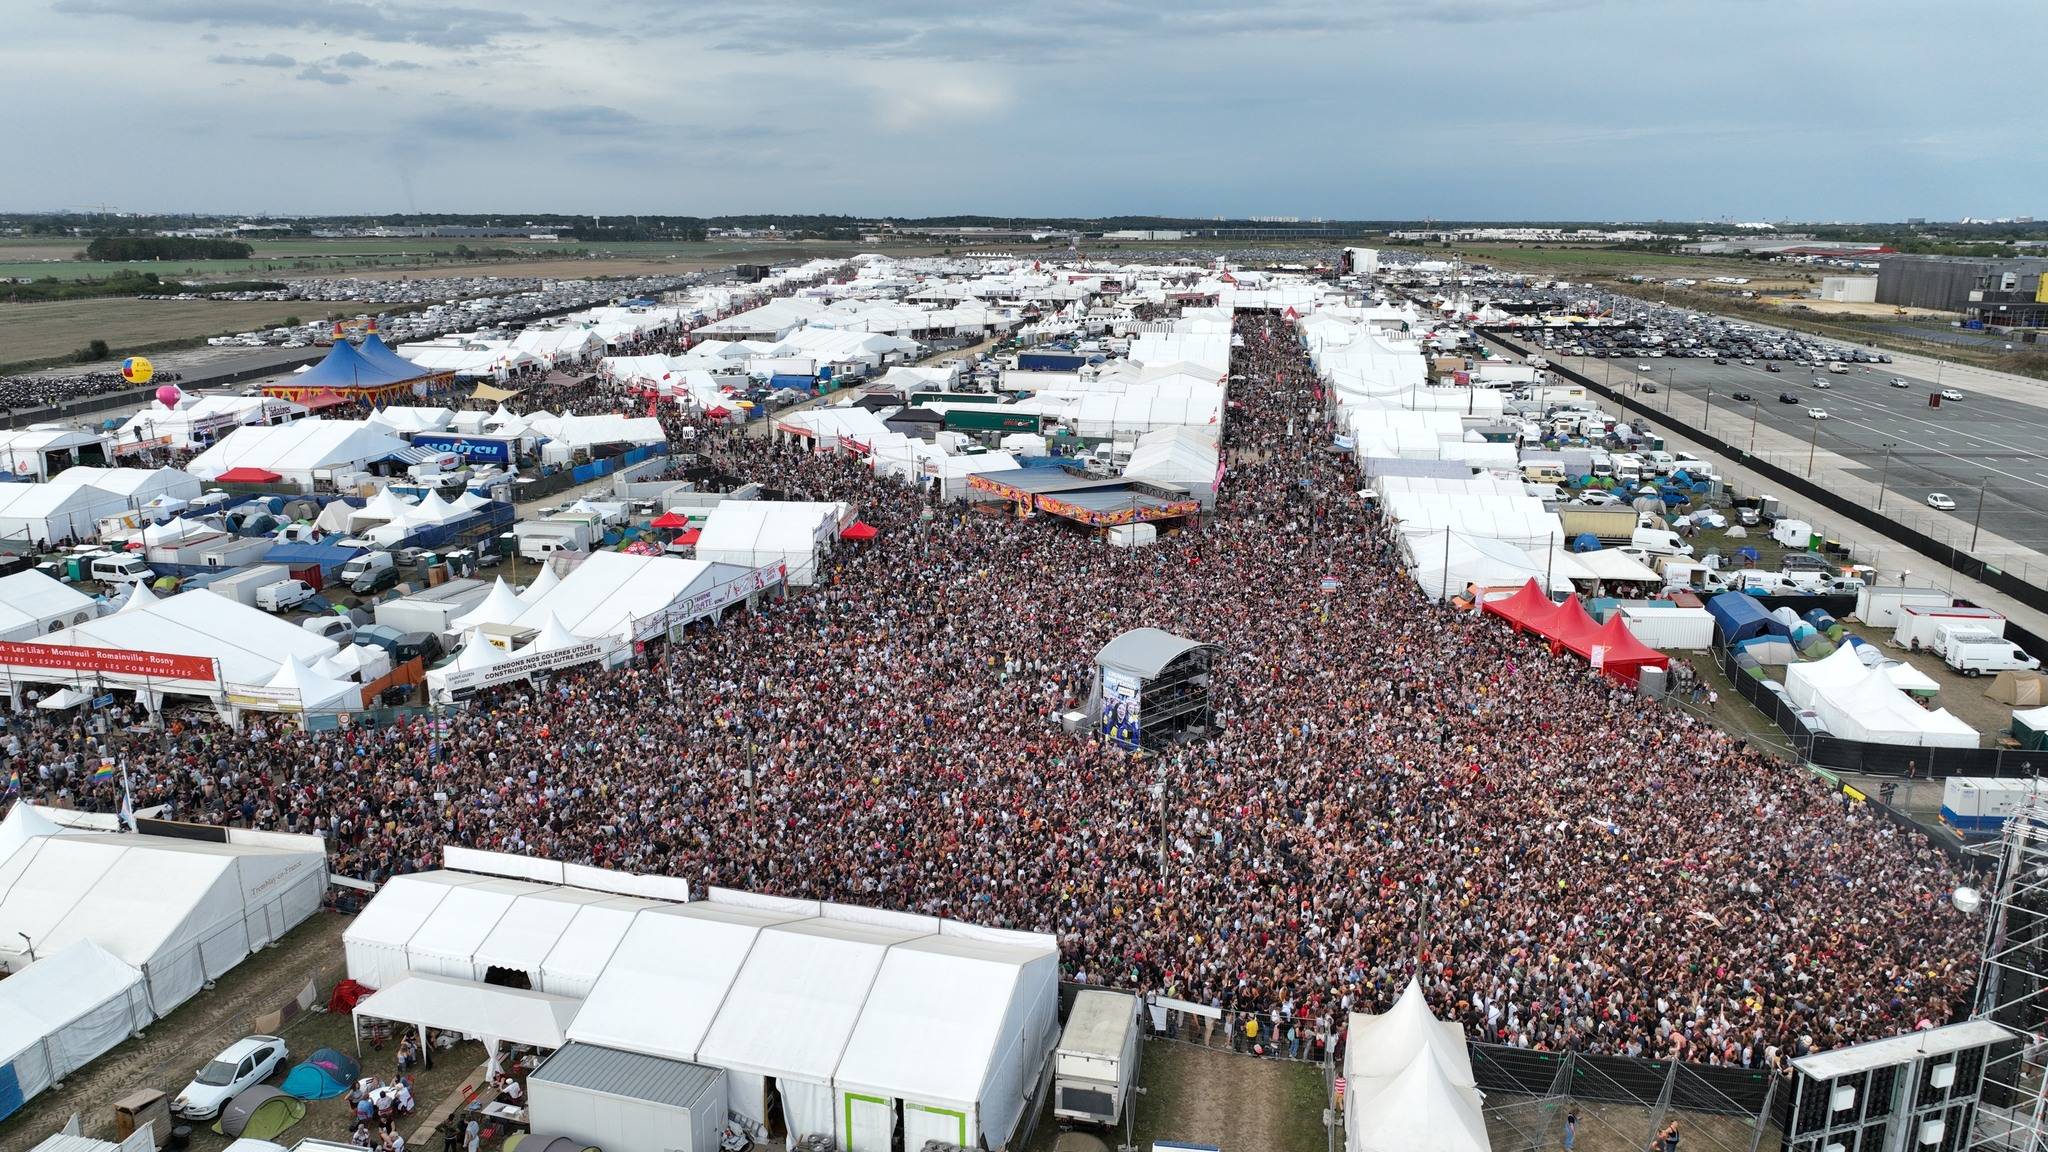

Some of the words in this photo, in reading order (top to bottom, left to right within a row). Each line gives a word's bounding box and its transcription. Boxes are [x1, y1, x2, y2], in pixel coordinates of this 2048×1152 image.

[12, 645, 25, 653] Les
[27, 646, 45, 655] Lilas
[51, 648, 90, 658] Montreuil
[96, 651, 143, 662] Romainville
[150, 655, 174, 667] Rosny
[30, 658, 72, 667] L'ESPOIR
[125, 665, 192, 677] COMMUNISTES
[484, 662, 537, 680] CONSTRUISONS
[538, 659, 552, 667] UNE
[553, 654, 574, 664] AUTRE
[576, 647, 601, 658] SOCIÉTÉ
[492, 660, 525, 672] RENDONS
[526, 656, 540, 664] NOS
[572, 643, 594, 654] UTILES
